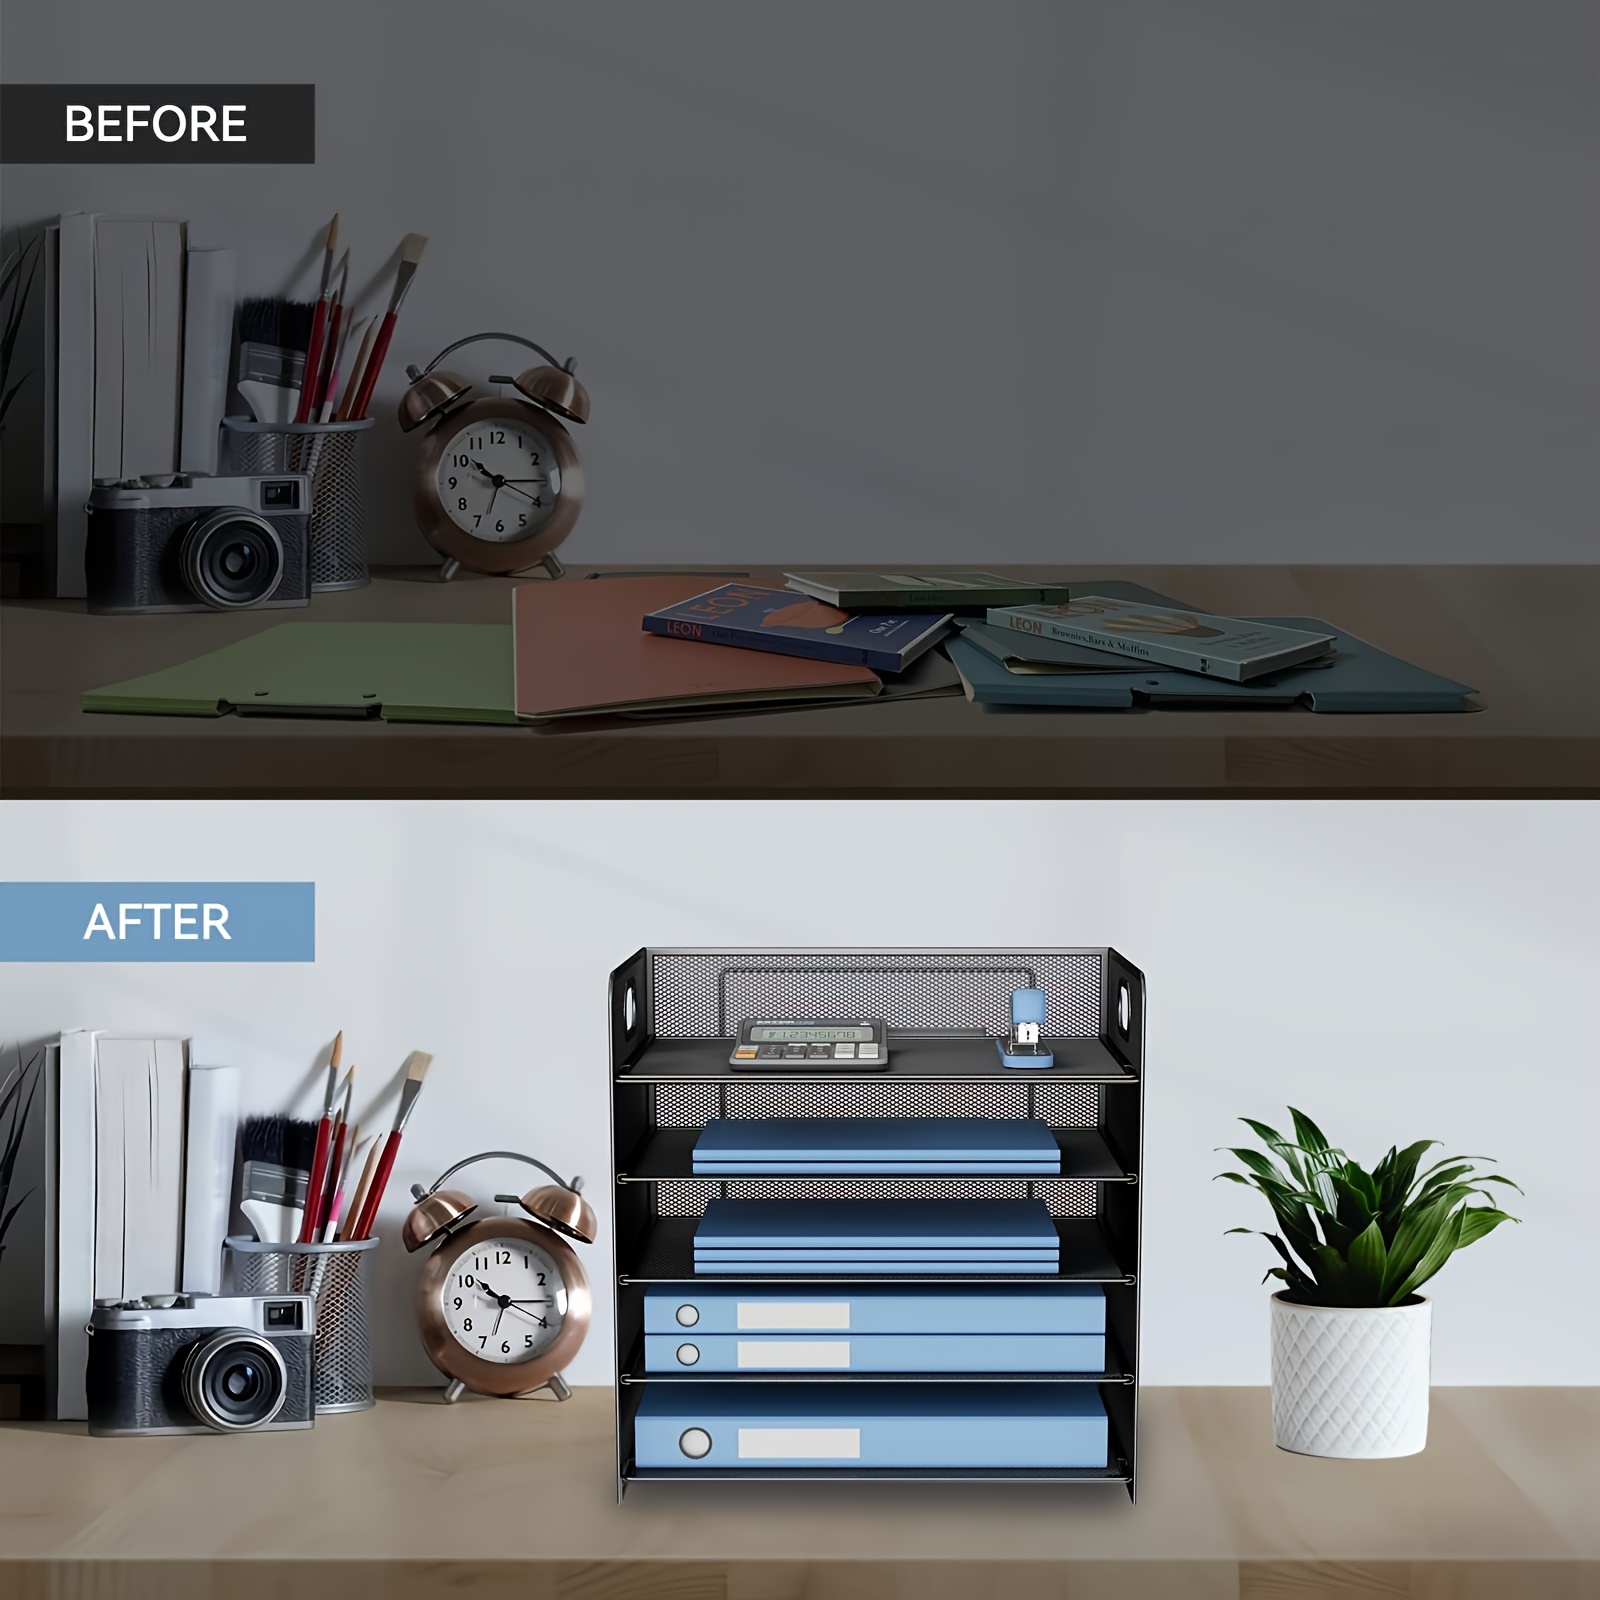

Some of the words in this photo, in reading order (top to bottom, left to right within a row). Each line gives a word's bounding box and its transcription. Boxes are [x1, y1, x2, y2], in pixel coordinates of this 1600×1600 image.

[470, 437, 482, 450] 11
[490, 431, 505, 444] 12
[453, 454, 469, 467] 10
[530, 453, 540, 465] 2
[448, 477, 457, 489] 9
[458, 497, 467, 510] 8
[473, 515, 482, 527] 7
[495, 520, 504, 532] 6
[518, 514, 527, 526] 5
[674, 588, 772, 620] LEON
[667, 620, 702, 638] LEON
[1009, 615, 1042, 635] LEON
[1107, 640, 1115, 649] &
[1117, 642, 1150, 656] Muffins
[475, 1257, 488, 1270] 11
[496, 1251, 511, 1264] 12
[459, 1274, 475, 1288] 10
[536, 1272, 546, 1286] 2
[453, 1297, 463, 1310] 9
[463, 1318, 473, 1332] 8
[478, 1335, 488, 1349] 7
[501, 1340, 511, 1354] 6
[524, 1334, 533, 1348] 5
